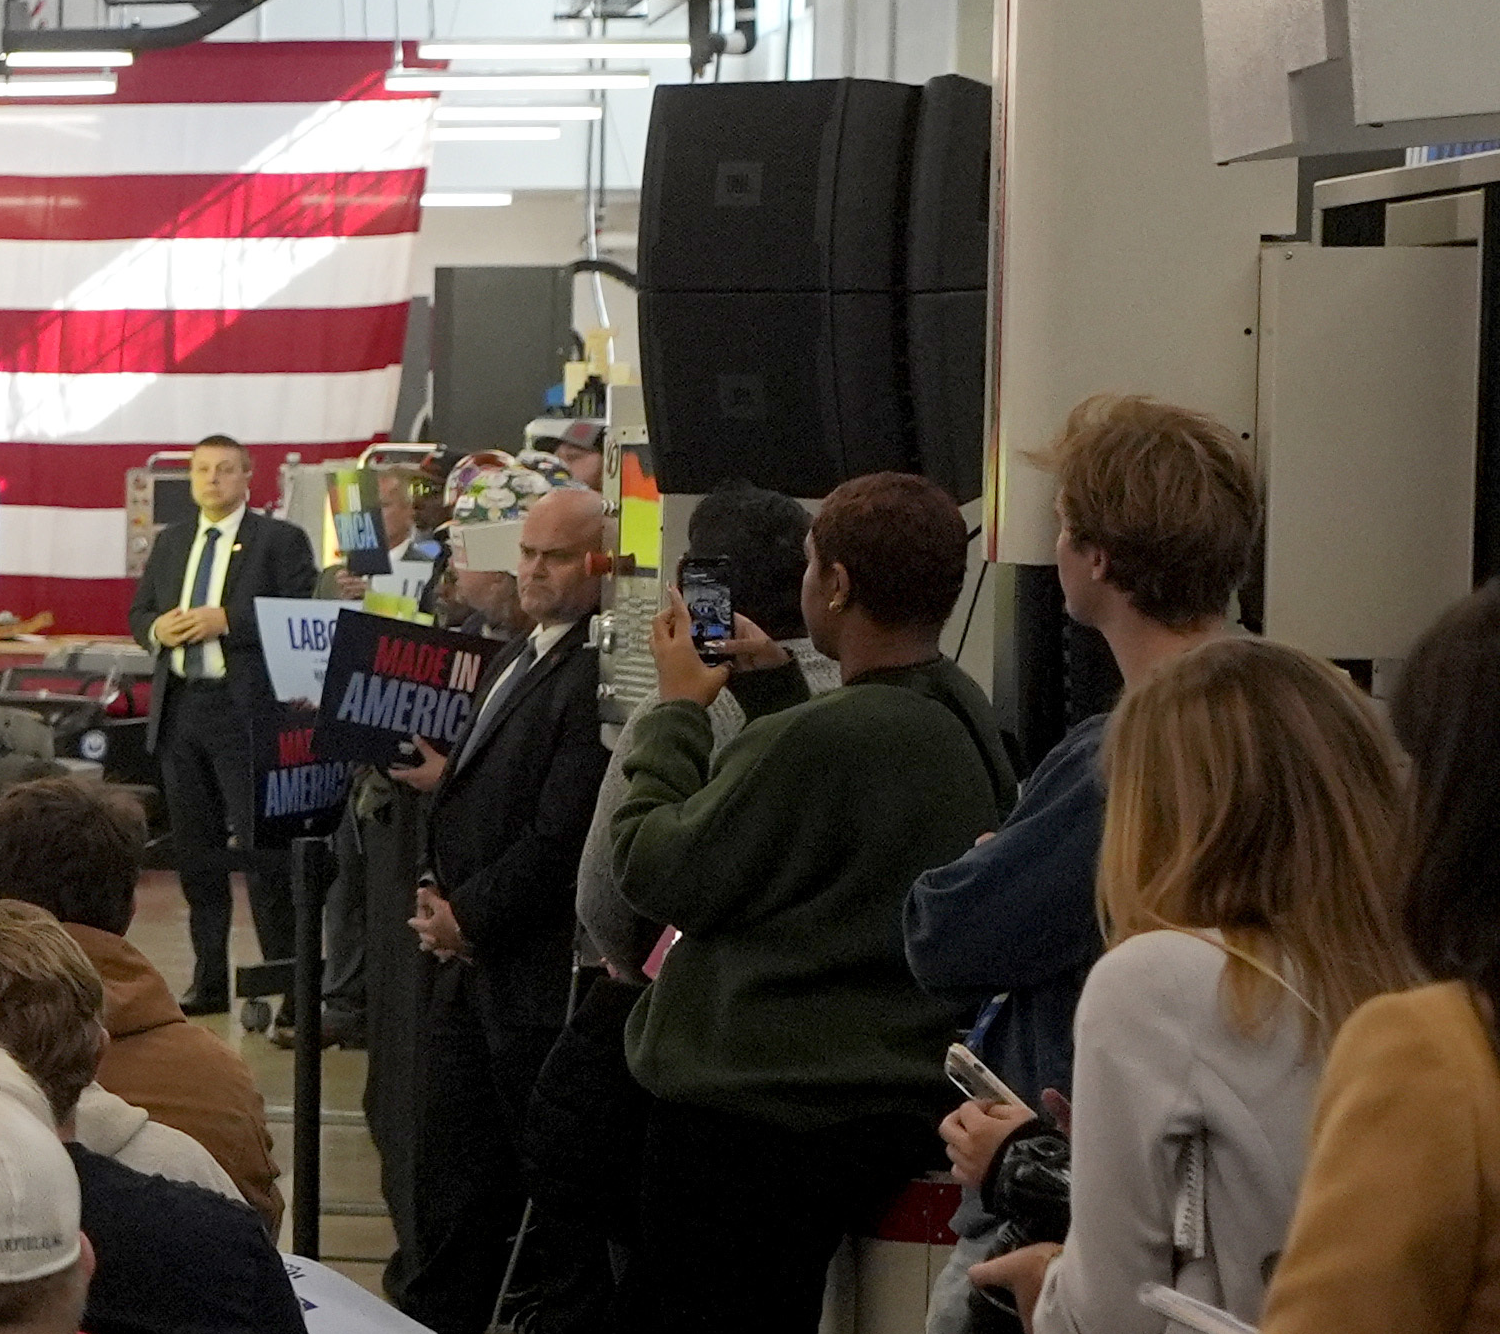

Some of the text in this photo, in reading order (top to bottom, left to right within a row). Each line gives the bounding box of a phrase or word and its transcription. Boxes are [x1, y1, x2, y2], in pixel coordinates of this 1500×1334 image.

[374, 635, 449, 685] MADE
[449, 650, 481, 693] IN
[336, 671, 471, 743] AMERIC
